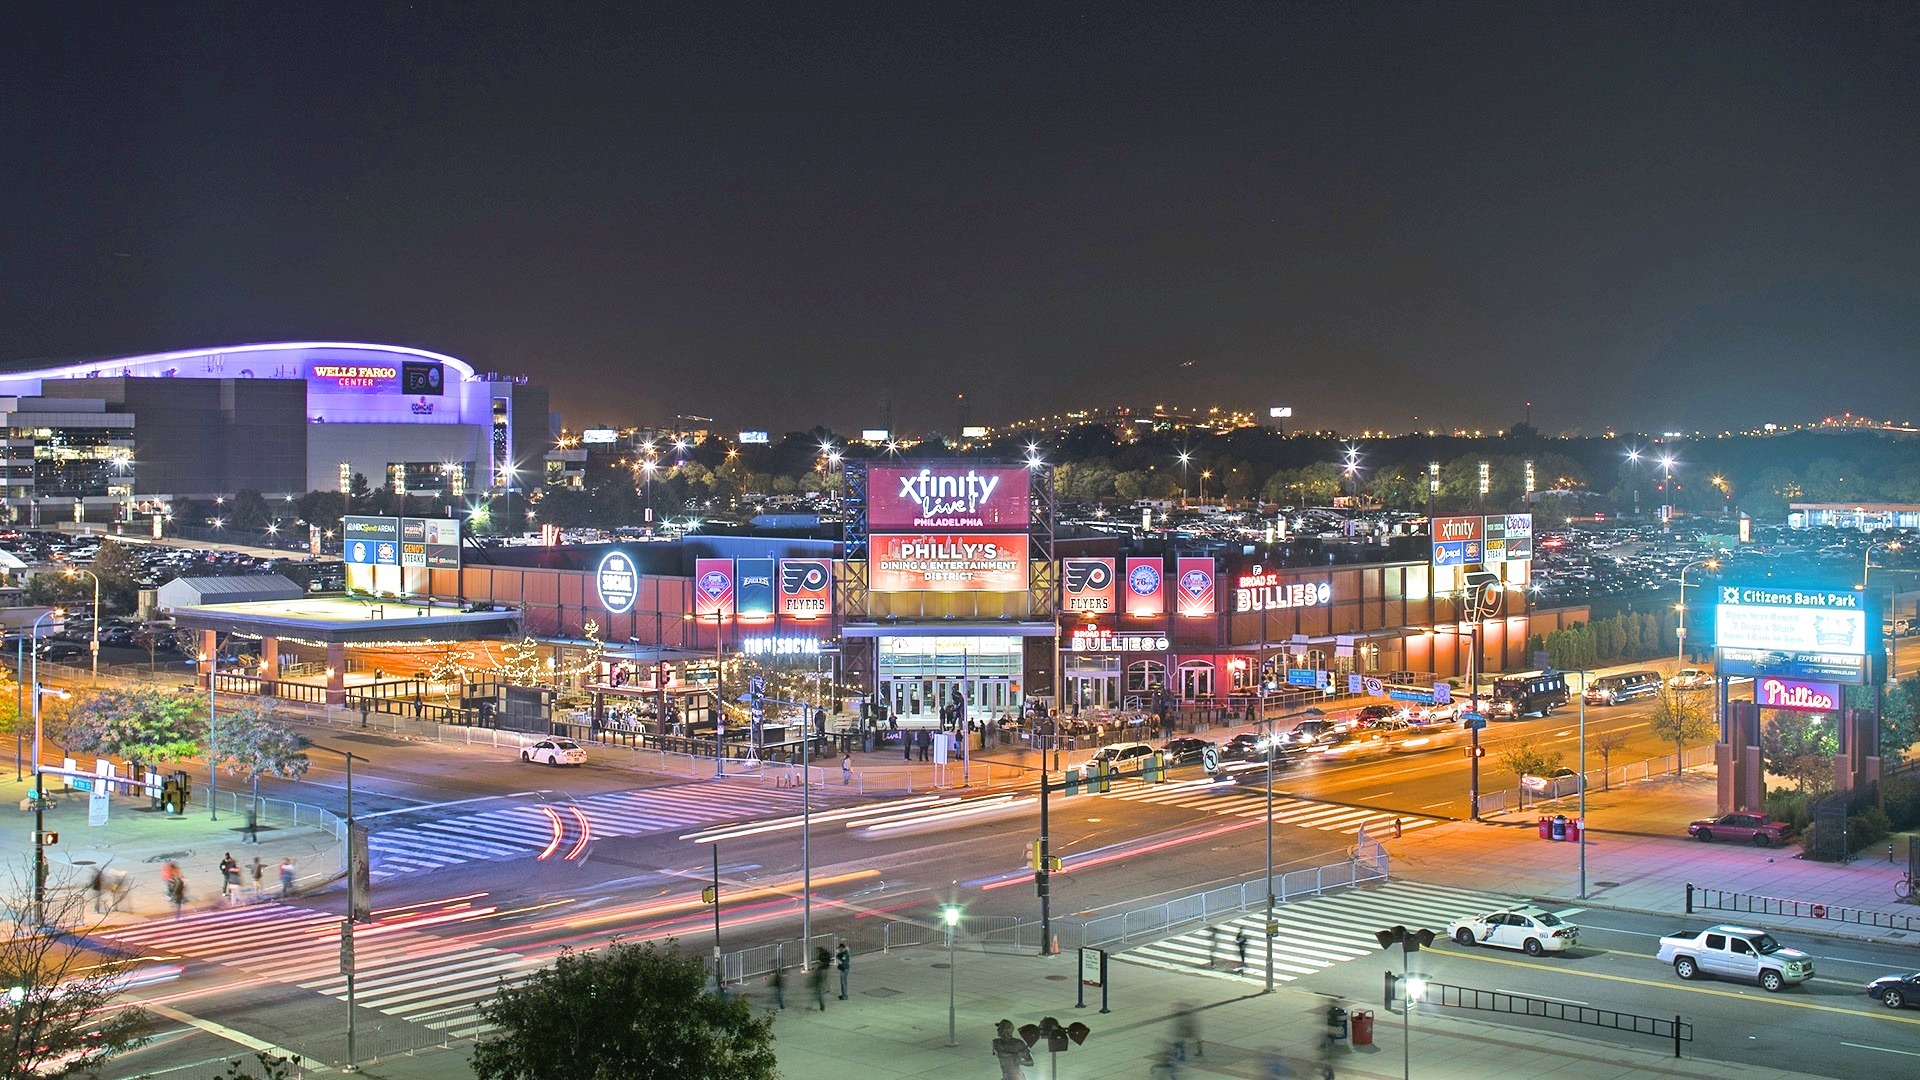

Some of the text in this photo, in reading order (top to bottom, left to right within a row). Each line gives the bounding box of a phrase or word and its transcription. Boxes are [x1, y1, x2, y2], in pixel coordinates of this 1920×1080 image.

[314, 366, 357, 377] WELLS
[358, 367, 397, 378] FARGO
[338, 378, 374, 387] CENTER
[899, 469, 1000, 504] xfinity
[923, 493, 976, 519] Live!
[914, 518, 984, 527] PHILADELPHIA
[377, 525, 396, 533] ARENA
[1442, 519, 1475, 541] xfinity
[403, 544, 424, 554] GENO'S
[901, 544, 997, 559] PHILLY'S
[404, 554, 424, 563] STEAKS
[881, 562, 1017, 570] DINING & ENTERTAINMENT
[743, 576, 770, 587] EAGLES
[924, 572, 974, 581] DISTRICT
[1239, 575, 1278, 587] BROAD ST.
[1237, 583, 1318, 612] BULLIES
[1743, 590, 1857, 607] Citizens Bank Park
[786, 599, 825, 610] FLYERS
[1070, 598, 1108, 609] FLYERS
[1074, 630, 1100, 638] BROAD
[777, 638, 820, 654] SOCIAL
[1072, 637, 1155, 652] BULLIES
[1797, 655, 1822, 664] EXPERT
[1763, 679, 1833, 709] Phillies
